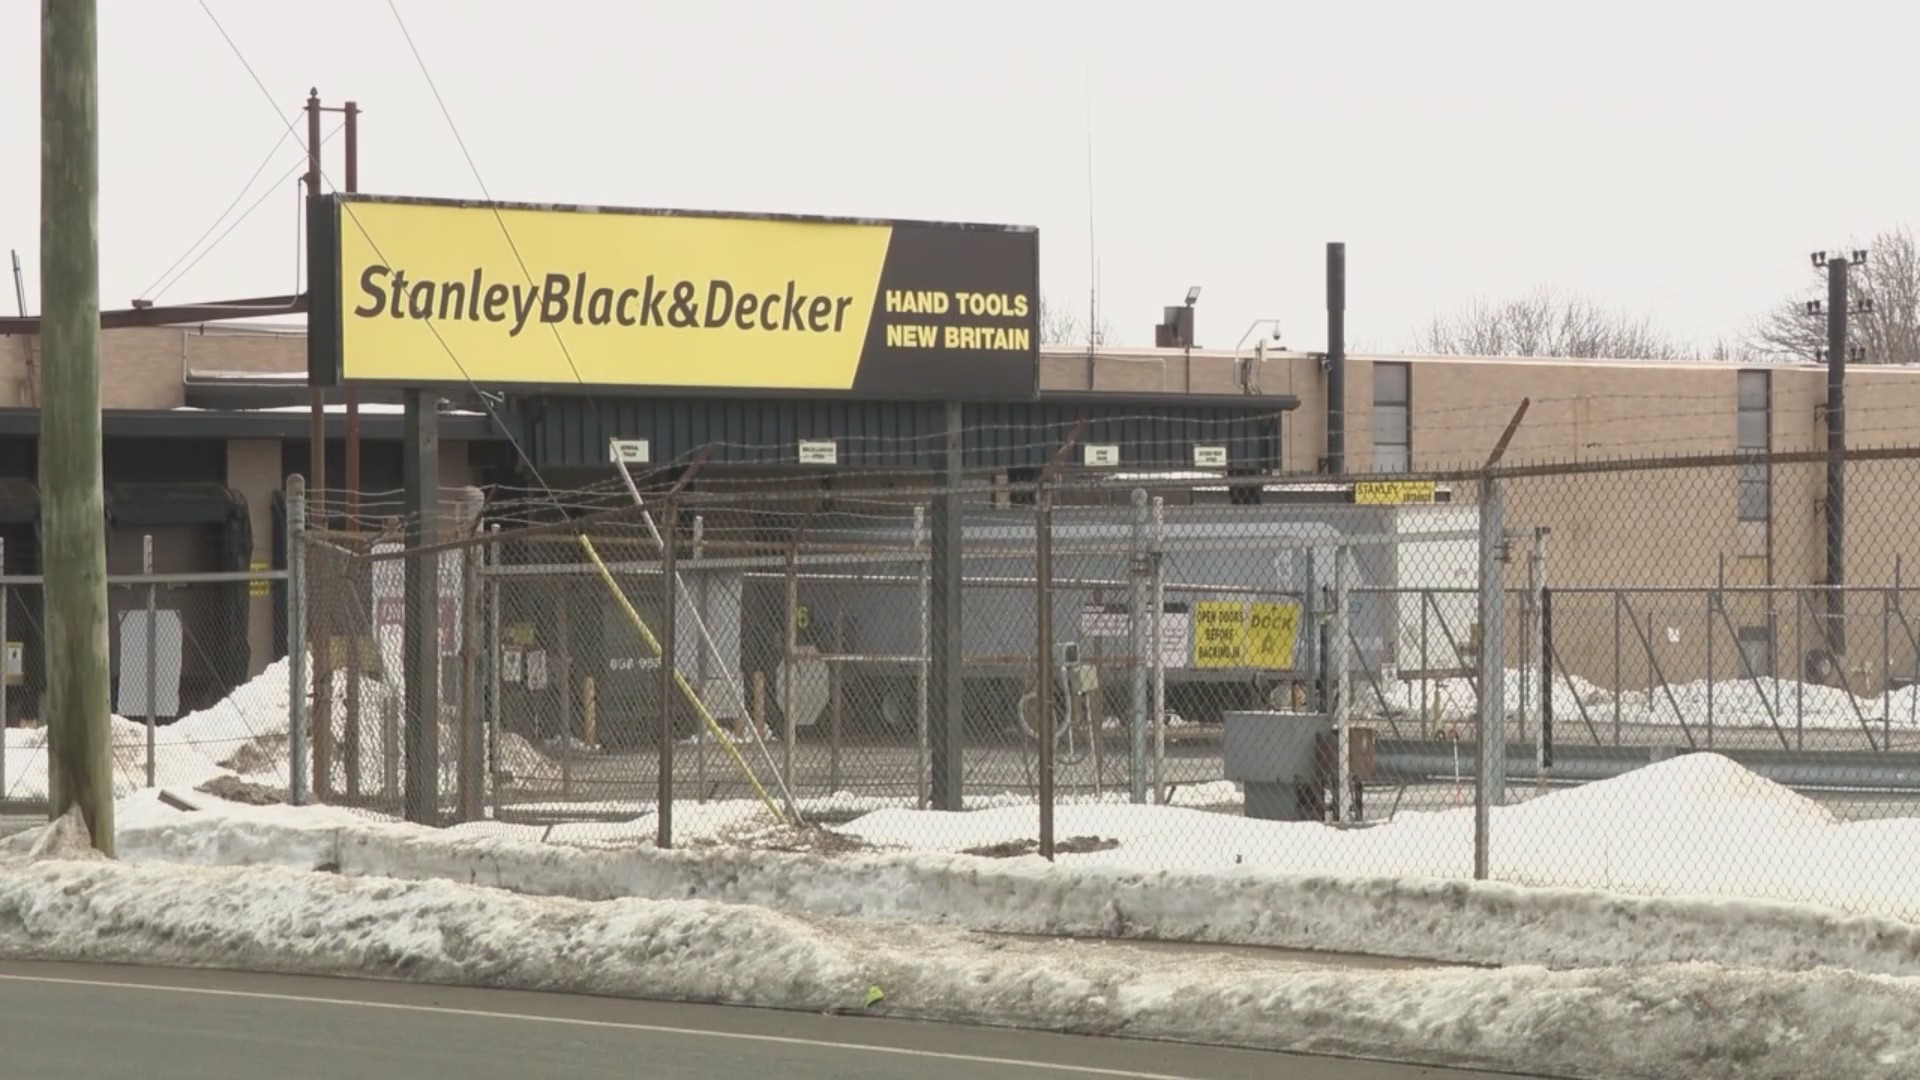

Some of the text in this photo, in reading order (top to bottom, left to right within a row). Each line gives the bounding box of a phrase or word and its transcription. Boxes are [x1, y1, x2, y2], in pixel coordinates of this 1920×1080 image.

[354, 264, 854, 337] StanleyBlack&Decker
[886, 290, 1029, 318] HAND TOOLS
[886, 324, 1030, 351] NEW BRITAIN
[1358, 483, 1400, 495] STANLEY
[1197, 610, 1243, 624] OPEN DOORS
[1250, 614, 1293, 631] DOCK
[1205, 627, 1234, 641] BEFORE
[1198, 645, 1230, 659] BACKING
